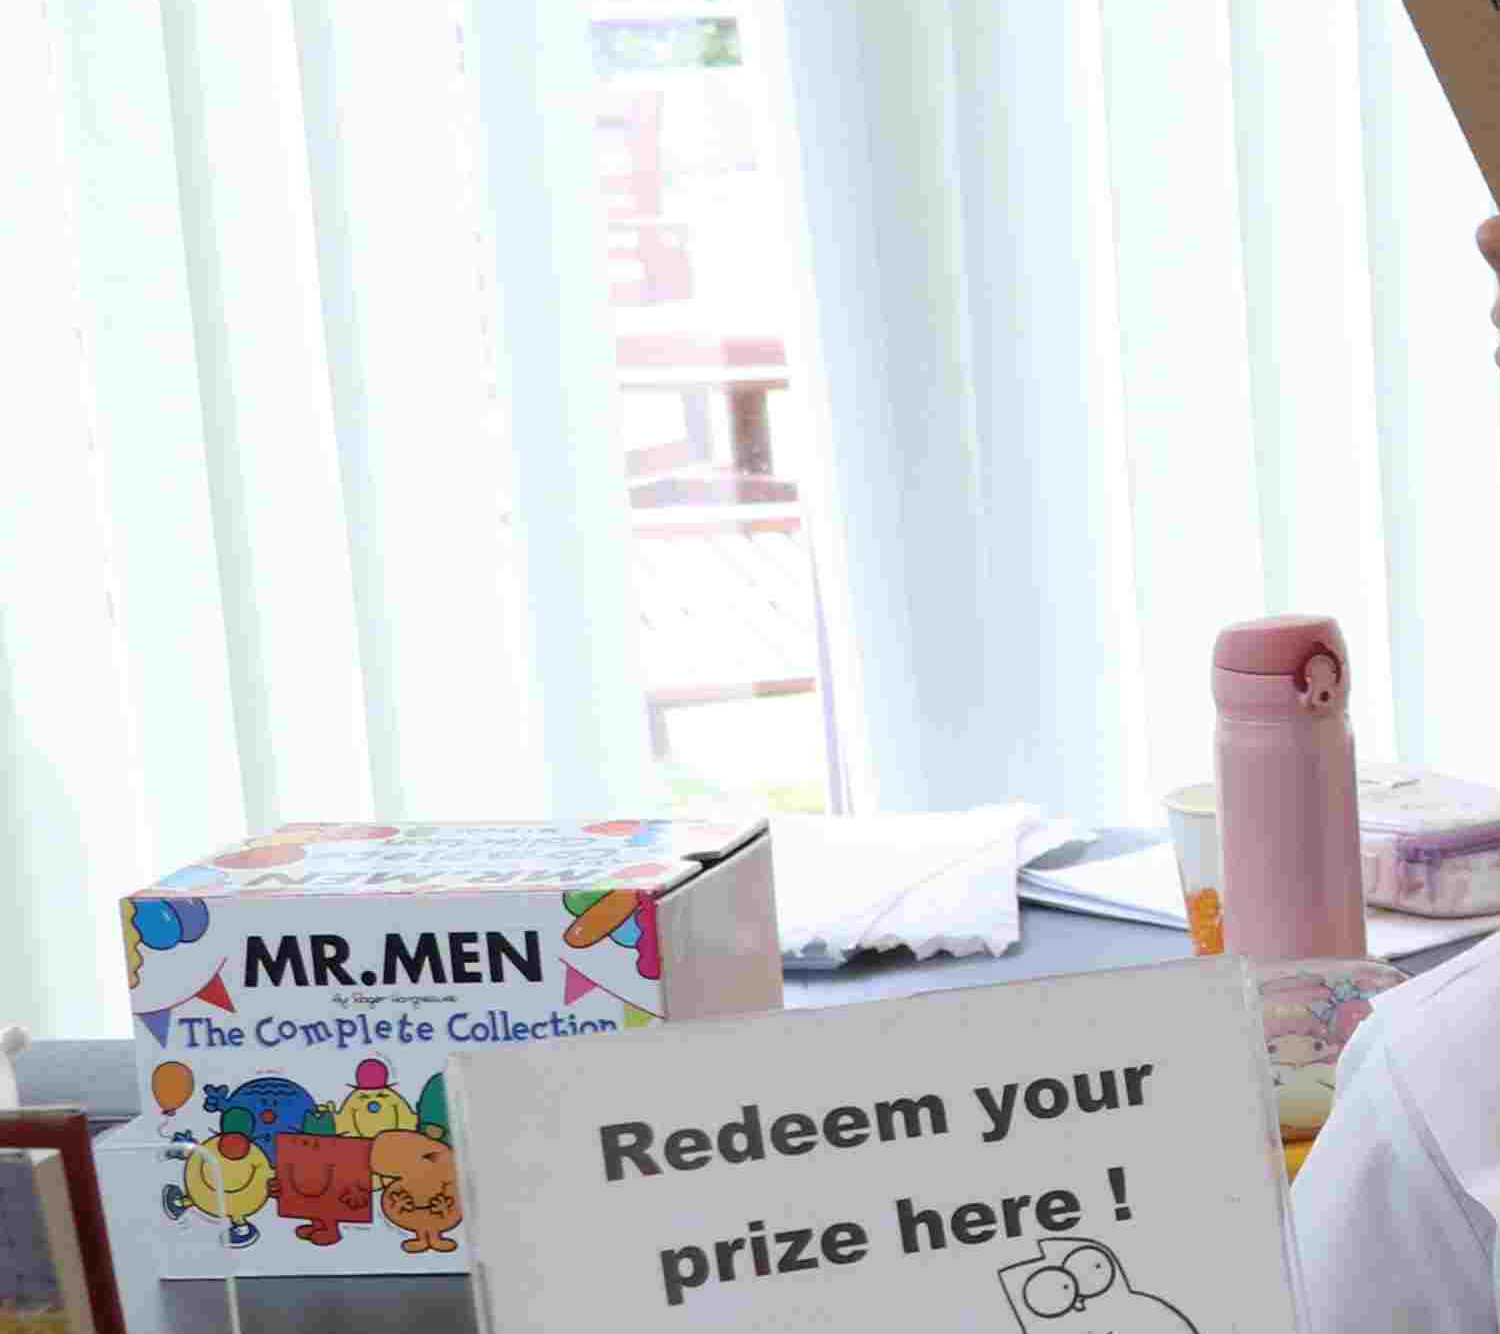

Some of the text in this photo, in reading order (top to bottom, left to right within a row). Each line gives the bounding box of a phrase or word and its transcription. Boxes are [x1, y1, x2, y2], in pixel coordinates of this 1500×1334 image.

[244, 930, 543, 988] MR.MEN
[181, 1017, 246, 1049] The
[255, 1010, 435, 1050] Complete
[599, 1063, 1153, 1182] Redeem your
[660, 1166, 1132, 1306] prize here !
